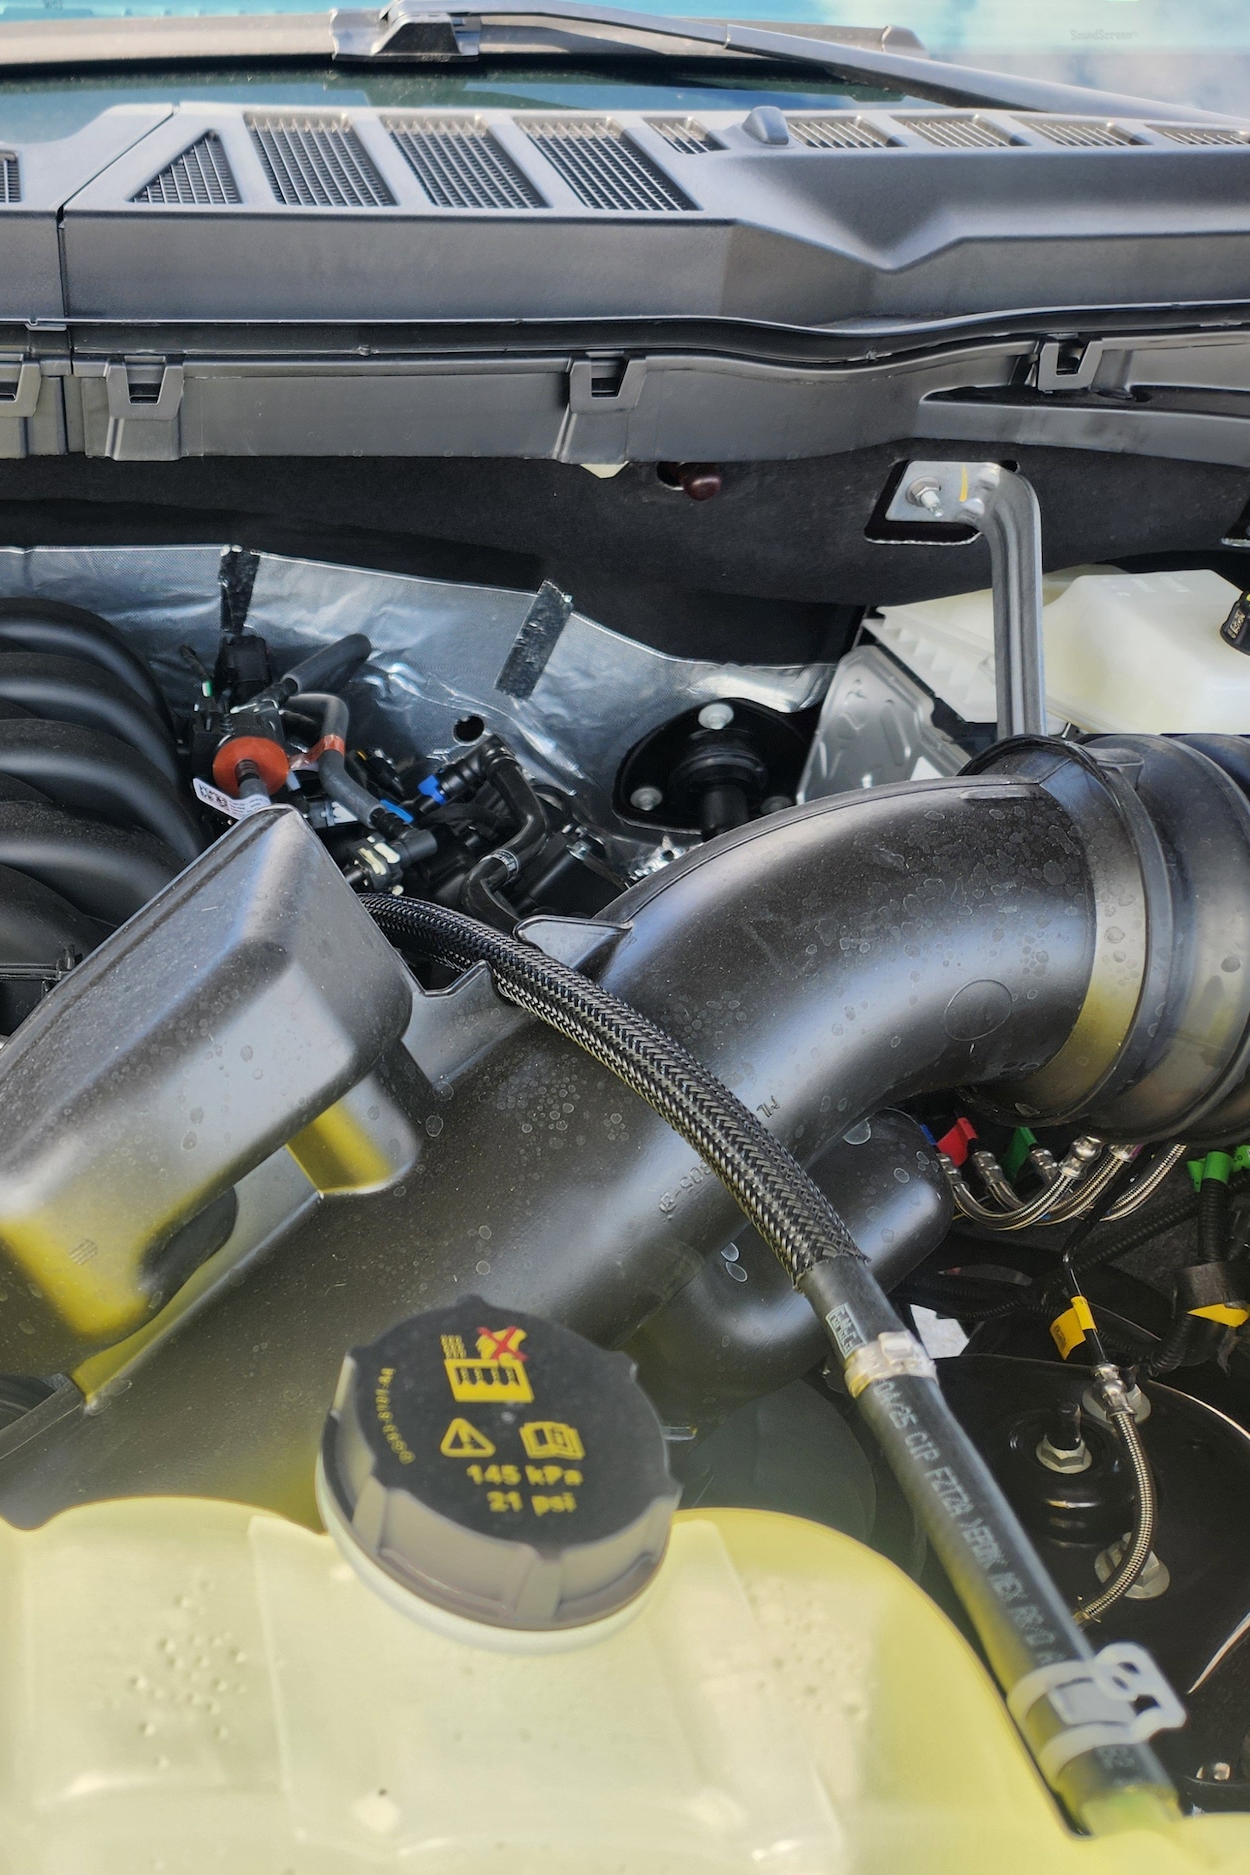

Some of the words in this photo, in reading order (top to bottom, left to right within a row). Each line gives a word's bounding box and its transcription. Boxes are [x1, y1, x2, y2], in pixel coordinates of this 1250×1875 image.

[466, 1463, 521, 1486] 145
[525, 1464, 583, 1487] kPa
[486, 1490, 523, 1513] 21
[531, 1491, 577, 1517] psi
